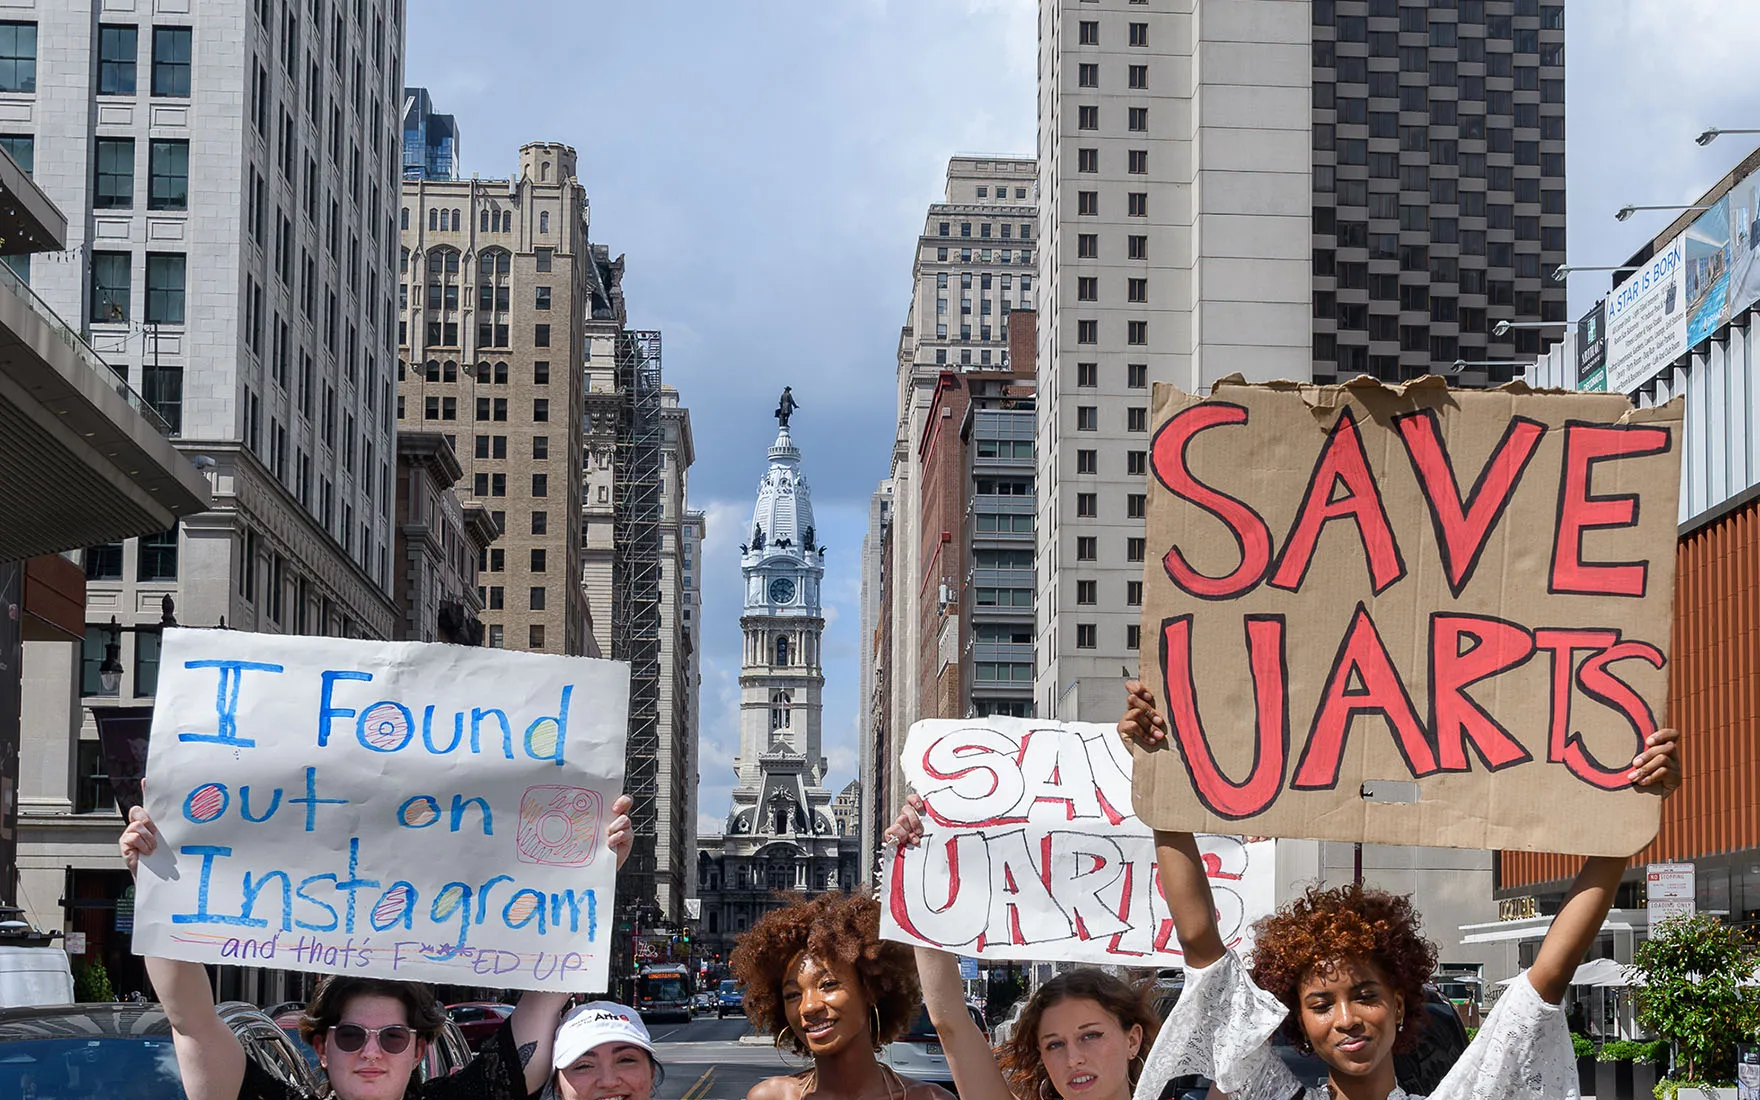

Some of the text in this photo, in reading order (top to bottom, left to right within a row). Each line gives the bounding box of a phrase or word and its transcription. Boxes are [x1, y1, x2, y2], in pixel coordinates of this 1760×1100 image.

[1609, 301, 1616, 320] A
[1617, 280, 1639, 312] STAR
[1641, 271, 1650, 292] IS
[1653, 246, 1681, 283] BORN
[1149, 400, 1672, 600] SAVE
[178, 659, 575, 766] I Found
[1160, 600, 1668, 821] UARTS
[182, 766, 494, 836] out on
[921, 727, 1140, 829] SAV
[171, 837, 598, 962] Instagram
[888, 828, 1250, 957] UARTS
[220, 935, 277, 960] and
[289, 935, 374, 969] that's
[533, 951, 583, 982] UP
